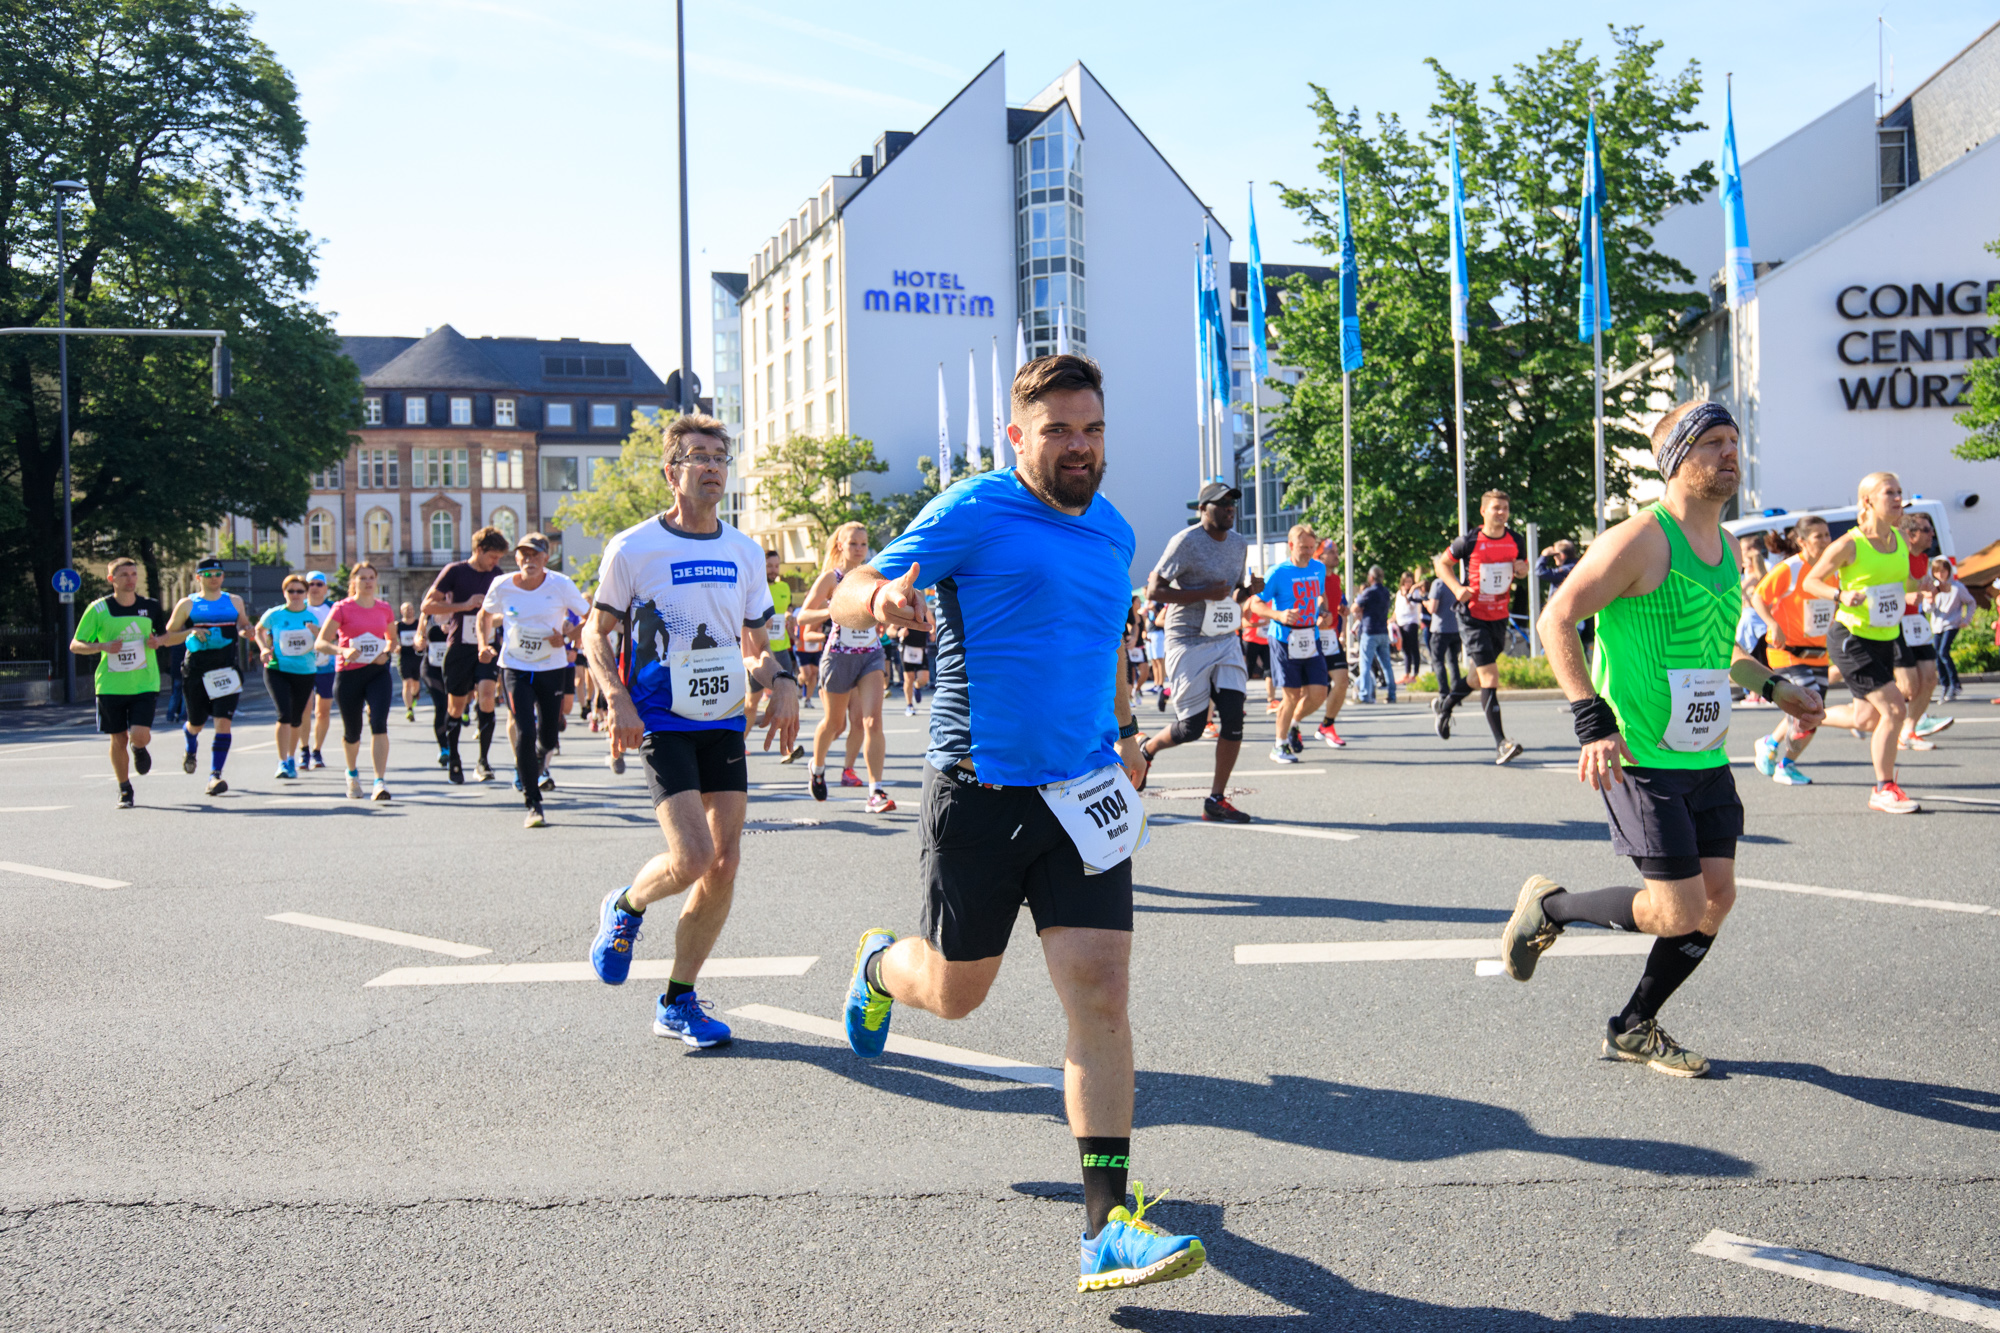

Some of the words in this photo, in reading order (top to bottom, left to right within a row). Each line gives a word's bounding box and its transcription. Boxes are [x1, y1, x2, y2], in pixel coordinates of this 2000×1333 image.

[893, 270, 965, 290] HOTEL
[1292, 580, 1320, 600] CHI
[1878, 601, 1898, 613] 2515
[1212, 612, 1234, 623] 2569
[360, 643, 379, 653] 1957
[519, 639, 542, 651] 2537
[117, 652, 137, 662] 1321
[688, 674, 729, 698] 2535
[701, 698, 718, 707] Peter
[1685, 701, 1720, 723] 2558
[1083, 788, 1129, 829] 1704
[1106, 821, 1129, 841] Markus
